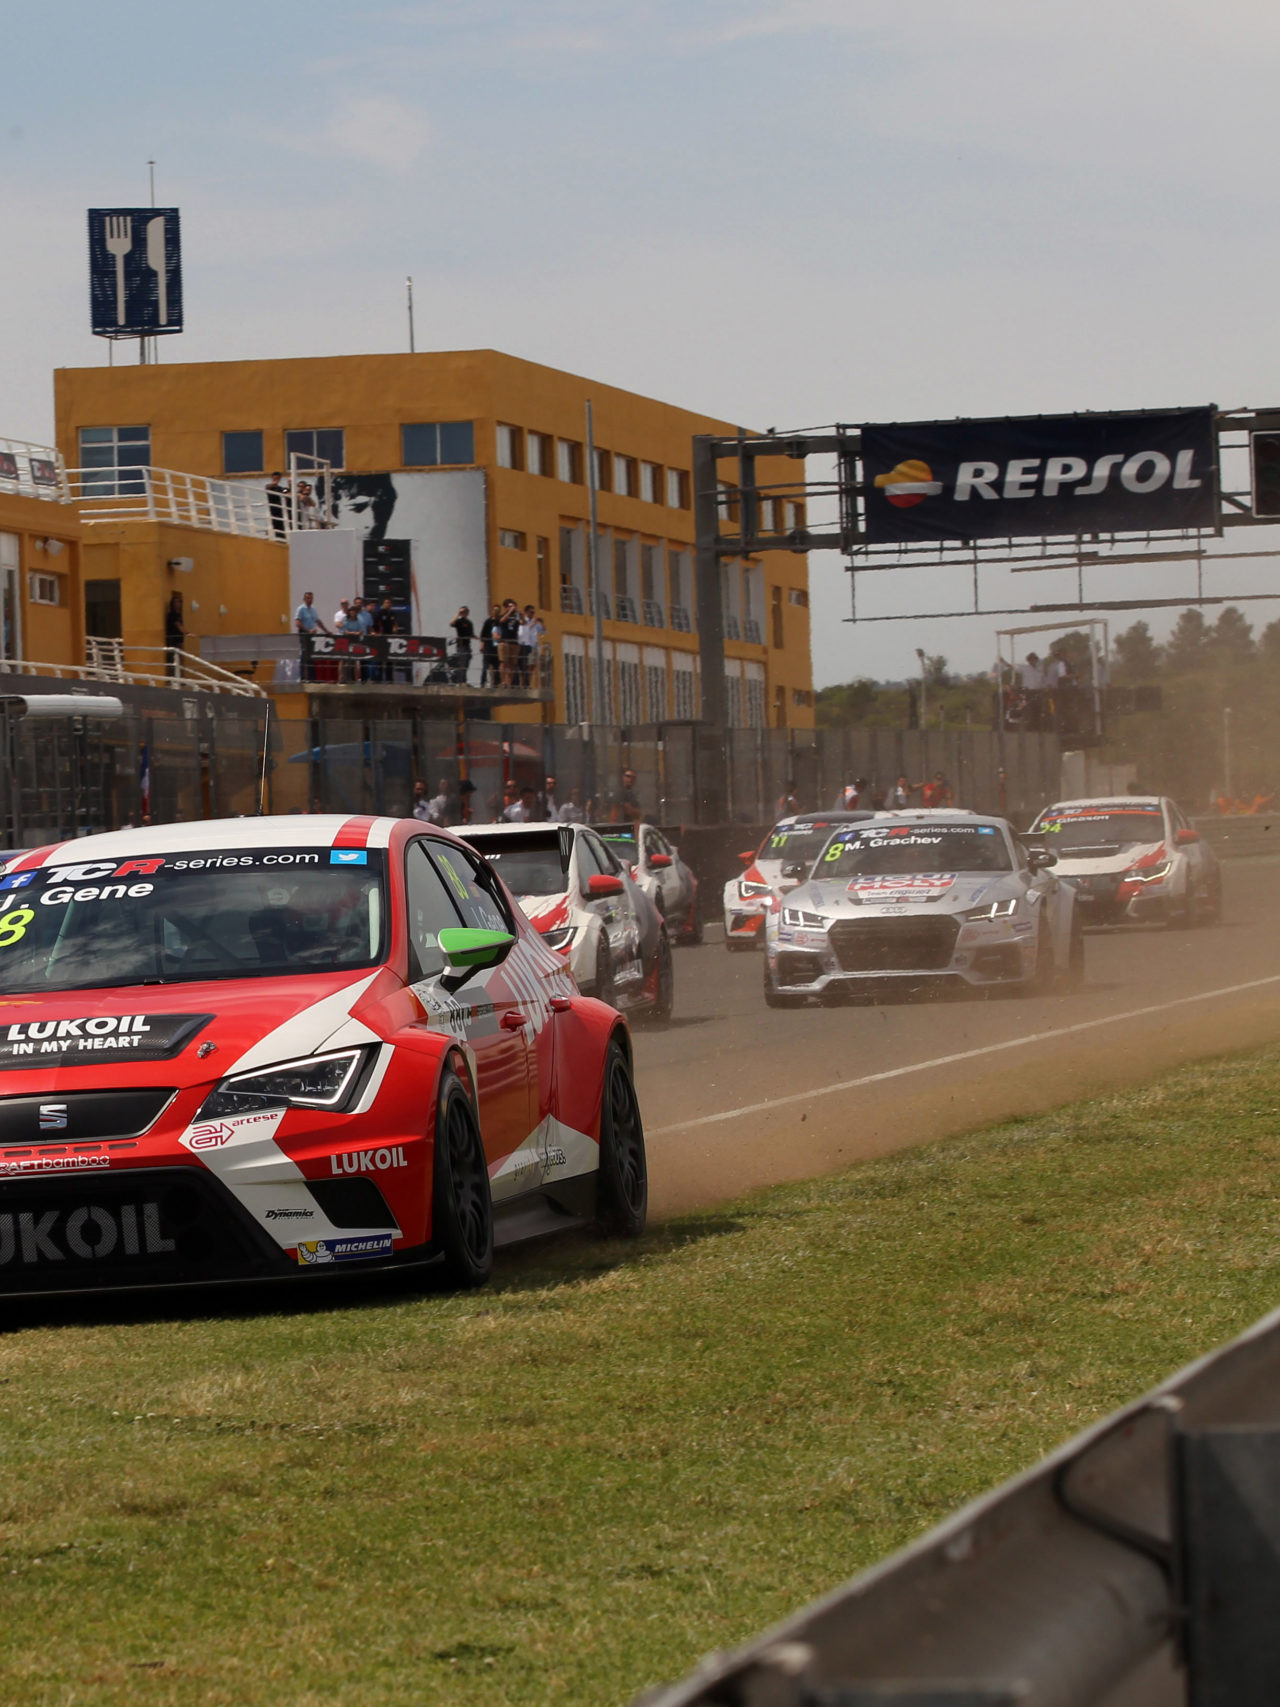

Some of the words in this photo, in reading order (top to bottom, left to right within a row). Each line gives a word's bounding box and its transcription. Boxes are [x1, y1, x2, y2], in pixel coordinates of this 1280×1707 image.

[953, 449, 1202, 501] REPSOL
[311, 637, 349, 653] TCR
[387, 638, 420, 654] TCR
[771, 836, 787, 848] 11
[844, 841, 865, 852] M.
[870, 836, 942, 848] Grachev
[824, 843, 844, 862] 8
[854, 879, 950, 890] MOLY
[40, 881, 154, 907] Gene
[7, 1015, 151, 1041] LUKOIL
[13, 1043, 34, 1055] IN
[40, 1040, 73, 1053] MY
[78, 1035, 142, 1050] HEART
[232, 1112, 278, 1127] arcese
[330, 1147, 408, 1175] LUKOIL
[265, 1209, 315, 1220] Dynamics
[334, 1239, 392, 1253] MICHELIN
